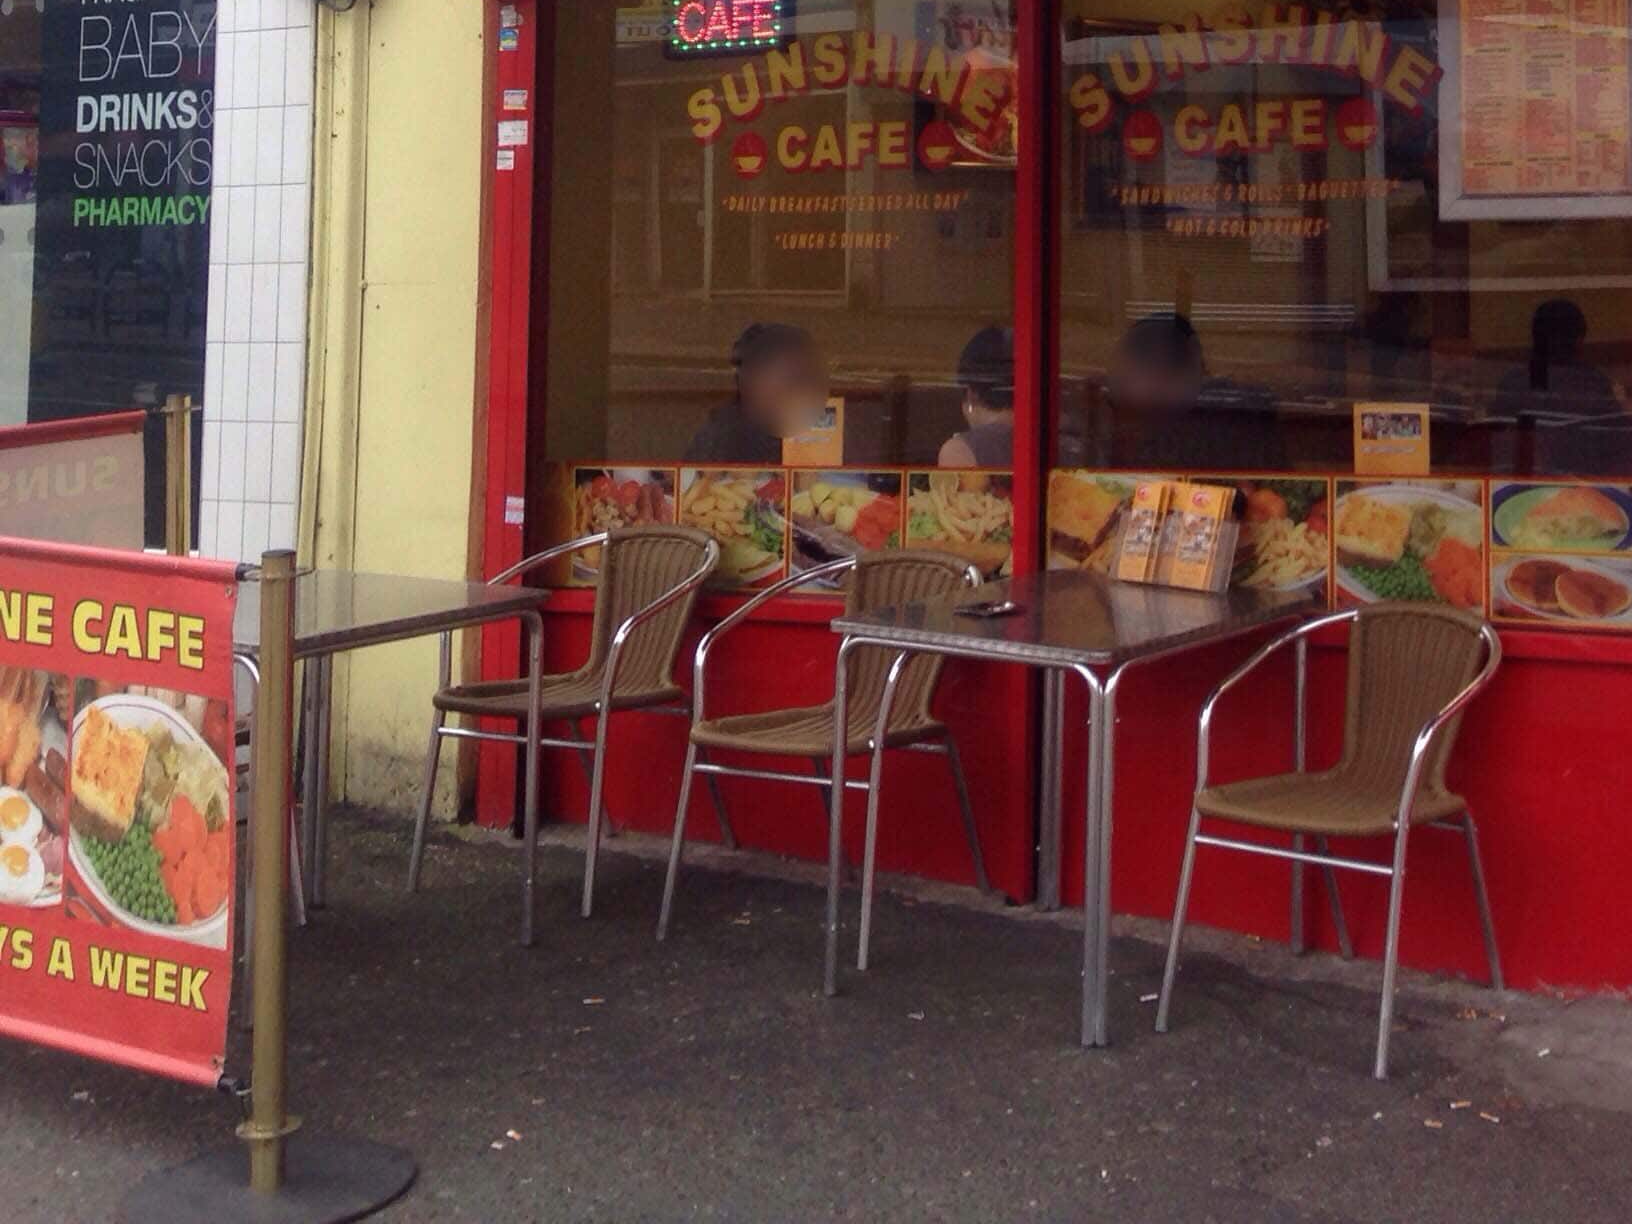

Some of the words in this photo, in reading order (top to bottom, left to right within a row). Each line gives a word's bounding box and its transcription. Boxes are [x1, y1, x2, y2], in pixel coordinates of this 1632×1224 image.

[79, 10, 218, 82] BABY
[1069, 6, 1443, 132] SUNSHINE
[687, 31, 1012, 146] SUNSHINE
[776, 122, 912, 173] CAFE
[1174, 97, 1329, 157] CAFE
[73, 138, 213, 189] SNACKS
[73, 193, 211, 227] PHARMACY
[71, 599, 205, 670] CAFE
[47, 937, 74, 982] A
[89, 945, 211, 1012] WEEK
